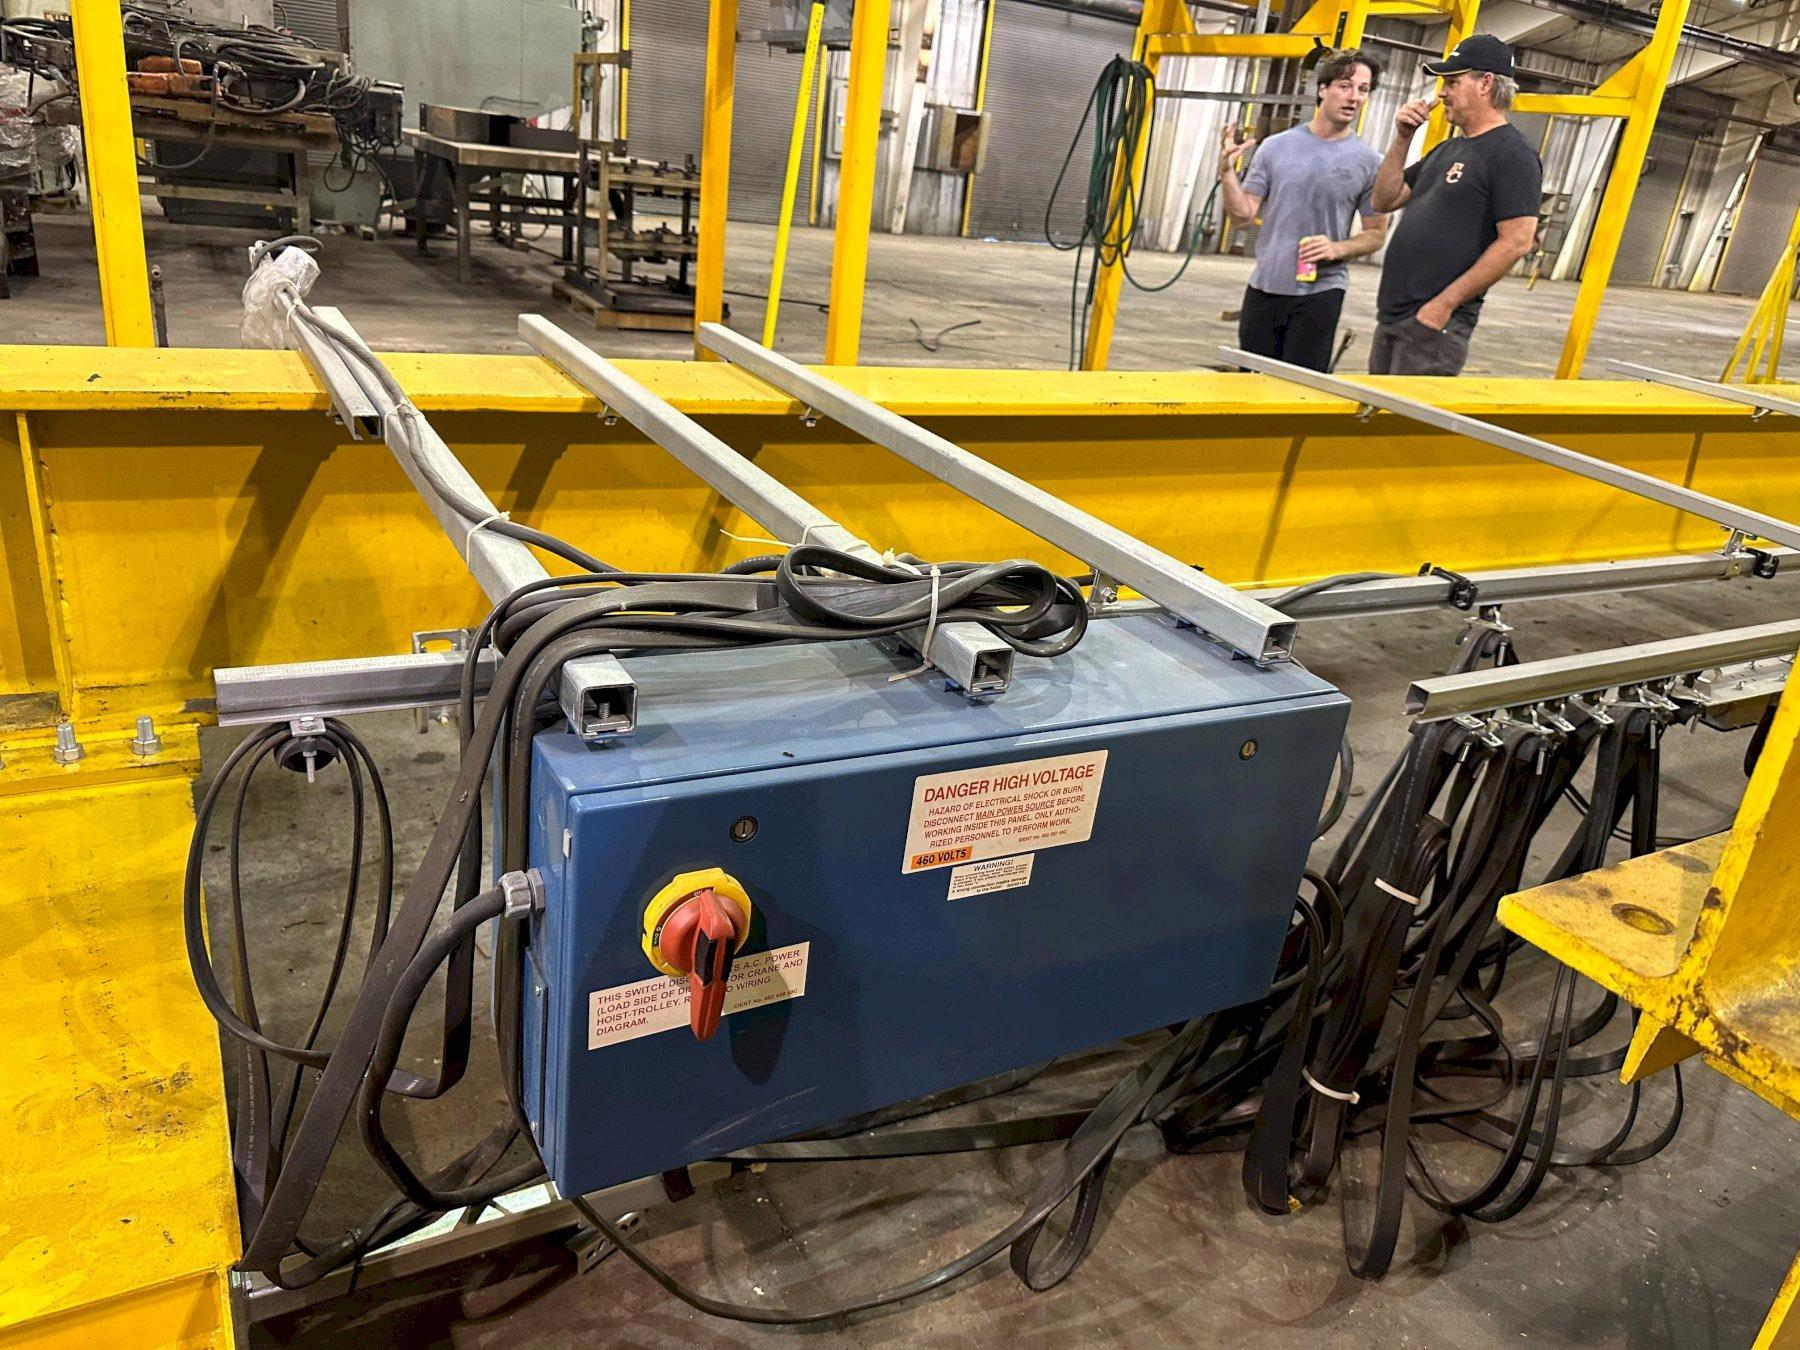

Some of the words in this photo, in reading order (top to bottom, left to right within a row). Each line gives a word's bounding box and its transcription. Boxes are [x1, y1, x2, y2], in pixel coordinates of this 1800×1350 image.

[924, 780, 989, 802] DANGER
[993, 772, 1029, 792] HIGH
[1033, 764, 1095, 785] VOLTAGE
[924, 813, 974, 827] DISCONNECT
[975, 809, 994, 820] MAIN
[996, 804, 1023, 816] POWER
[1025, 800, 1055, 811] SOURCE
[1057, 795, 1085, 806] BEFORE
[929, 804, 961, 816] HAZARD
[963, 802, 974, 811] OF
[975, 795, 1021, 808] ELECTRICAL
[1024, 790, 1050, 801] SHOCK
[1050, 788, 1062, 796] OR
[1063, 785, 1084, 795] BURN.
[924, 826, 961, 838] WORKING
[963, 821, 988, 832] INSIDE
[989, 817, 1006, 827] THIS
[1034, 810, 1055, 819] ONLY
[1054, 806, 1081, 816] AUTHO-
[930, 838, 953, 848] RIZED
[954, 829, 1000, 844] PERSONNEL
[1002, 827, 1011, 835] TO
[1012, 821, 1048, 833] PERFORM
[1049, 817, 1072, 827] WORK.
[916, 854, 935, 865] 460
[937, 848, 967, 862] VOLTS
[974, 859, 1014, 871] WARNING!
[743, 960, 762, 970] A.C.
[764, 950, 800, 964] POWER
[747, 964, 780, 978] CRANE
[783, 959, 803, 970] AND
[597, 993, 621, 1005] THIS
[624, 982, 665, 998] SWITCH
[736, 976, 771, 990] WIRING
[596, 1001, 630, 1016] (LOAD
[633, 994, 657, 1006] SIDE
[660, 989, 675, 999] OF
[733, 1000, 751, 1009] IDENT
[596, 1017, 649, 1036] DIAGRAM.
